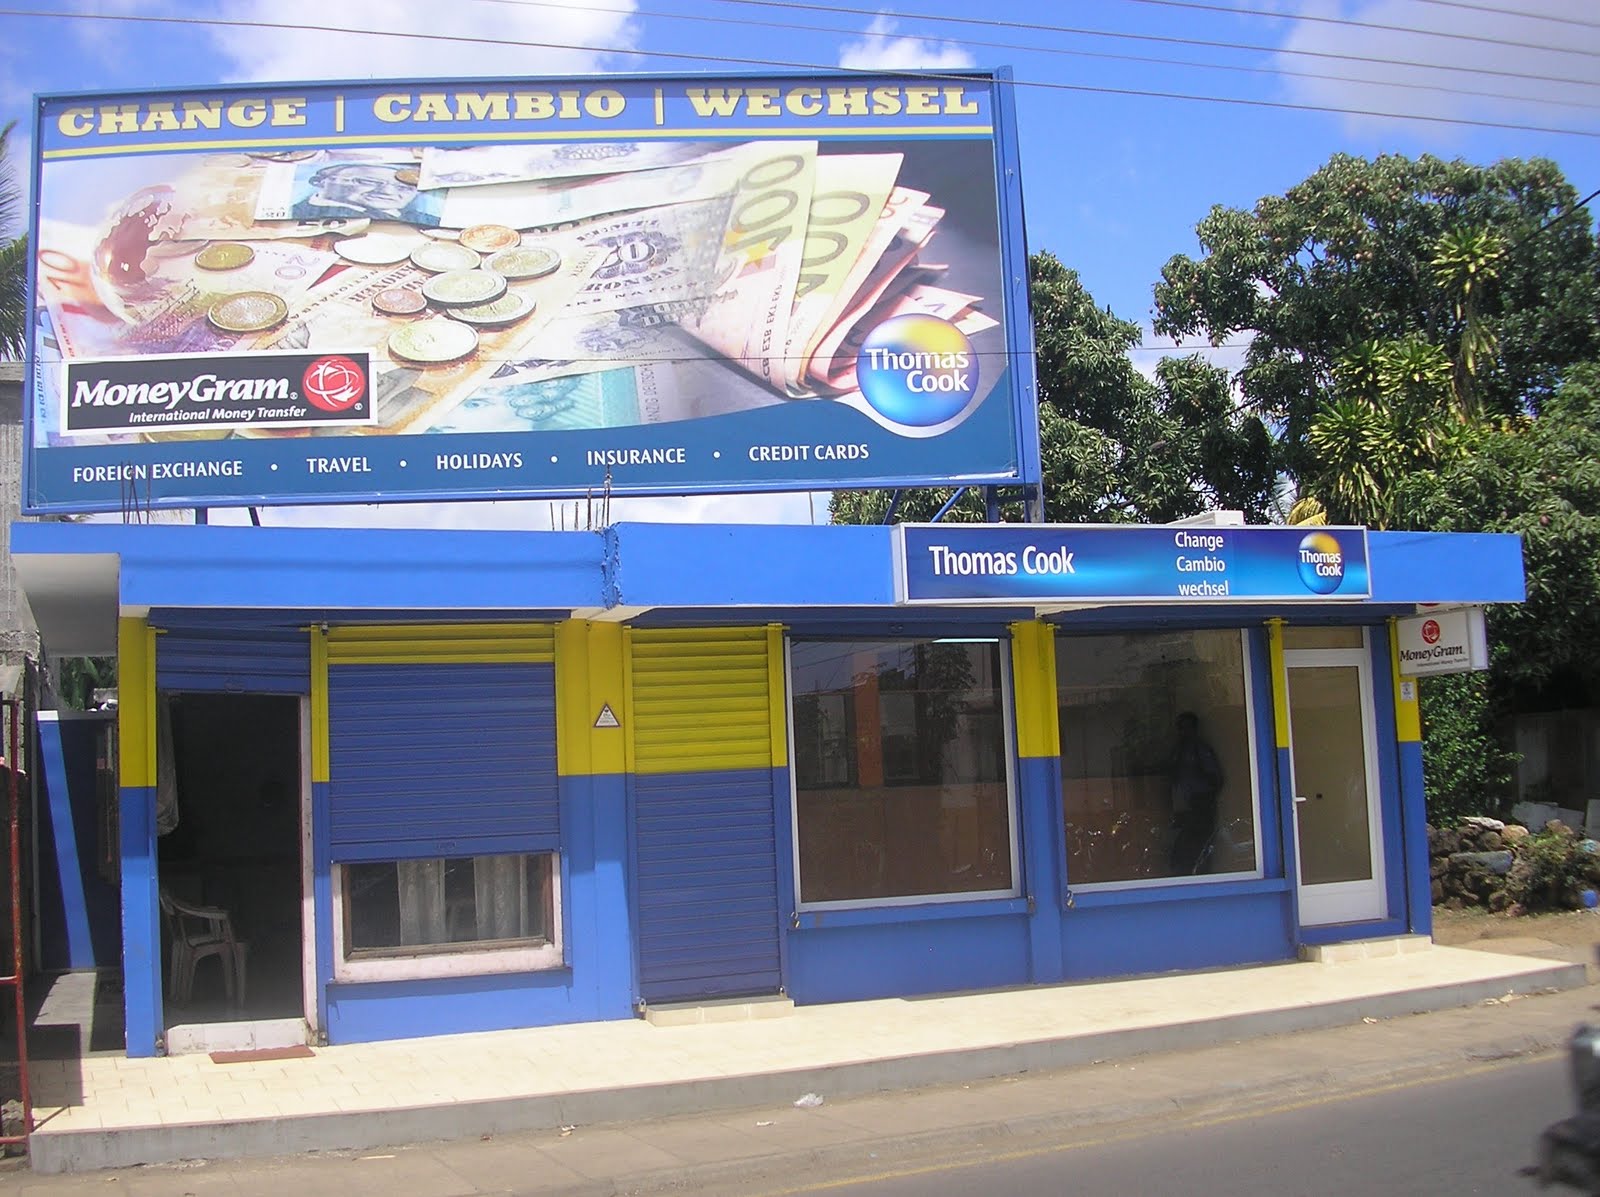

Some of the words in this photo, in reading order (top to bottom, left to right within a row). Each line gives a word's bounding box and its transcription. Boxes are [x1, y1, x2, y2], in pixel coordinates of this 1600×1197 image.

[57, 97, 307, 138] CHANGE
[373, 88, 627, 123] CAMBIO
[686, 86, 980, 118] WECHSEL
[865, 348, 970, 371] Thomas
[906, 369, 970, 393] Cook
[129, 408, 210, 423] International
[212, 408, 255, 422] Money
[257, 406, 307, 419] Transfer
[436, 452, 524, 471] HOLIDAYS
[586, 447, 686, 466] INSURANCE
[748, 446, 810, 463] CREDIT
[814, 443, 870, 461] CARDS
[152, 461, 243, 479] EXCHANGE
[307, 456, 372, 474] TRAVEL
[1175, 531, 1224, 551] Change
[928, 545, 1017, 576] Thomas
[1022, 545, 1076, 576] Cook
[1176, 556, 1226, 572] Cambio
[1299, 550, 1341, 564] Thomas
[1316, 563, 1342, 577] Cook
[1178, 580, 1230, 596] wechsel
[1400, 645, 1463, 662] MoneyGram
